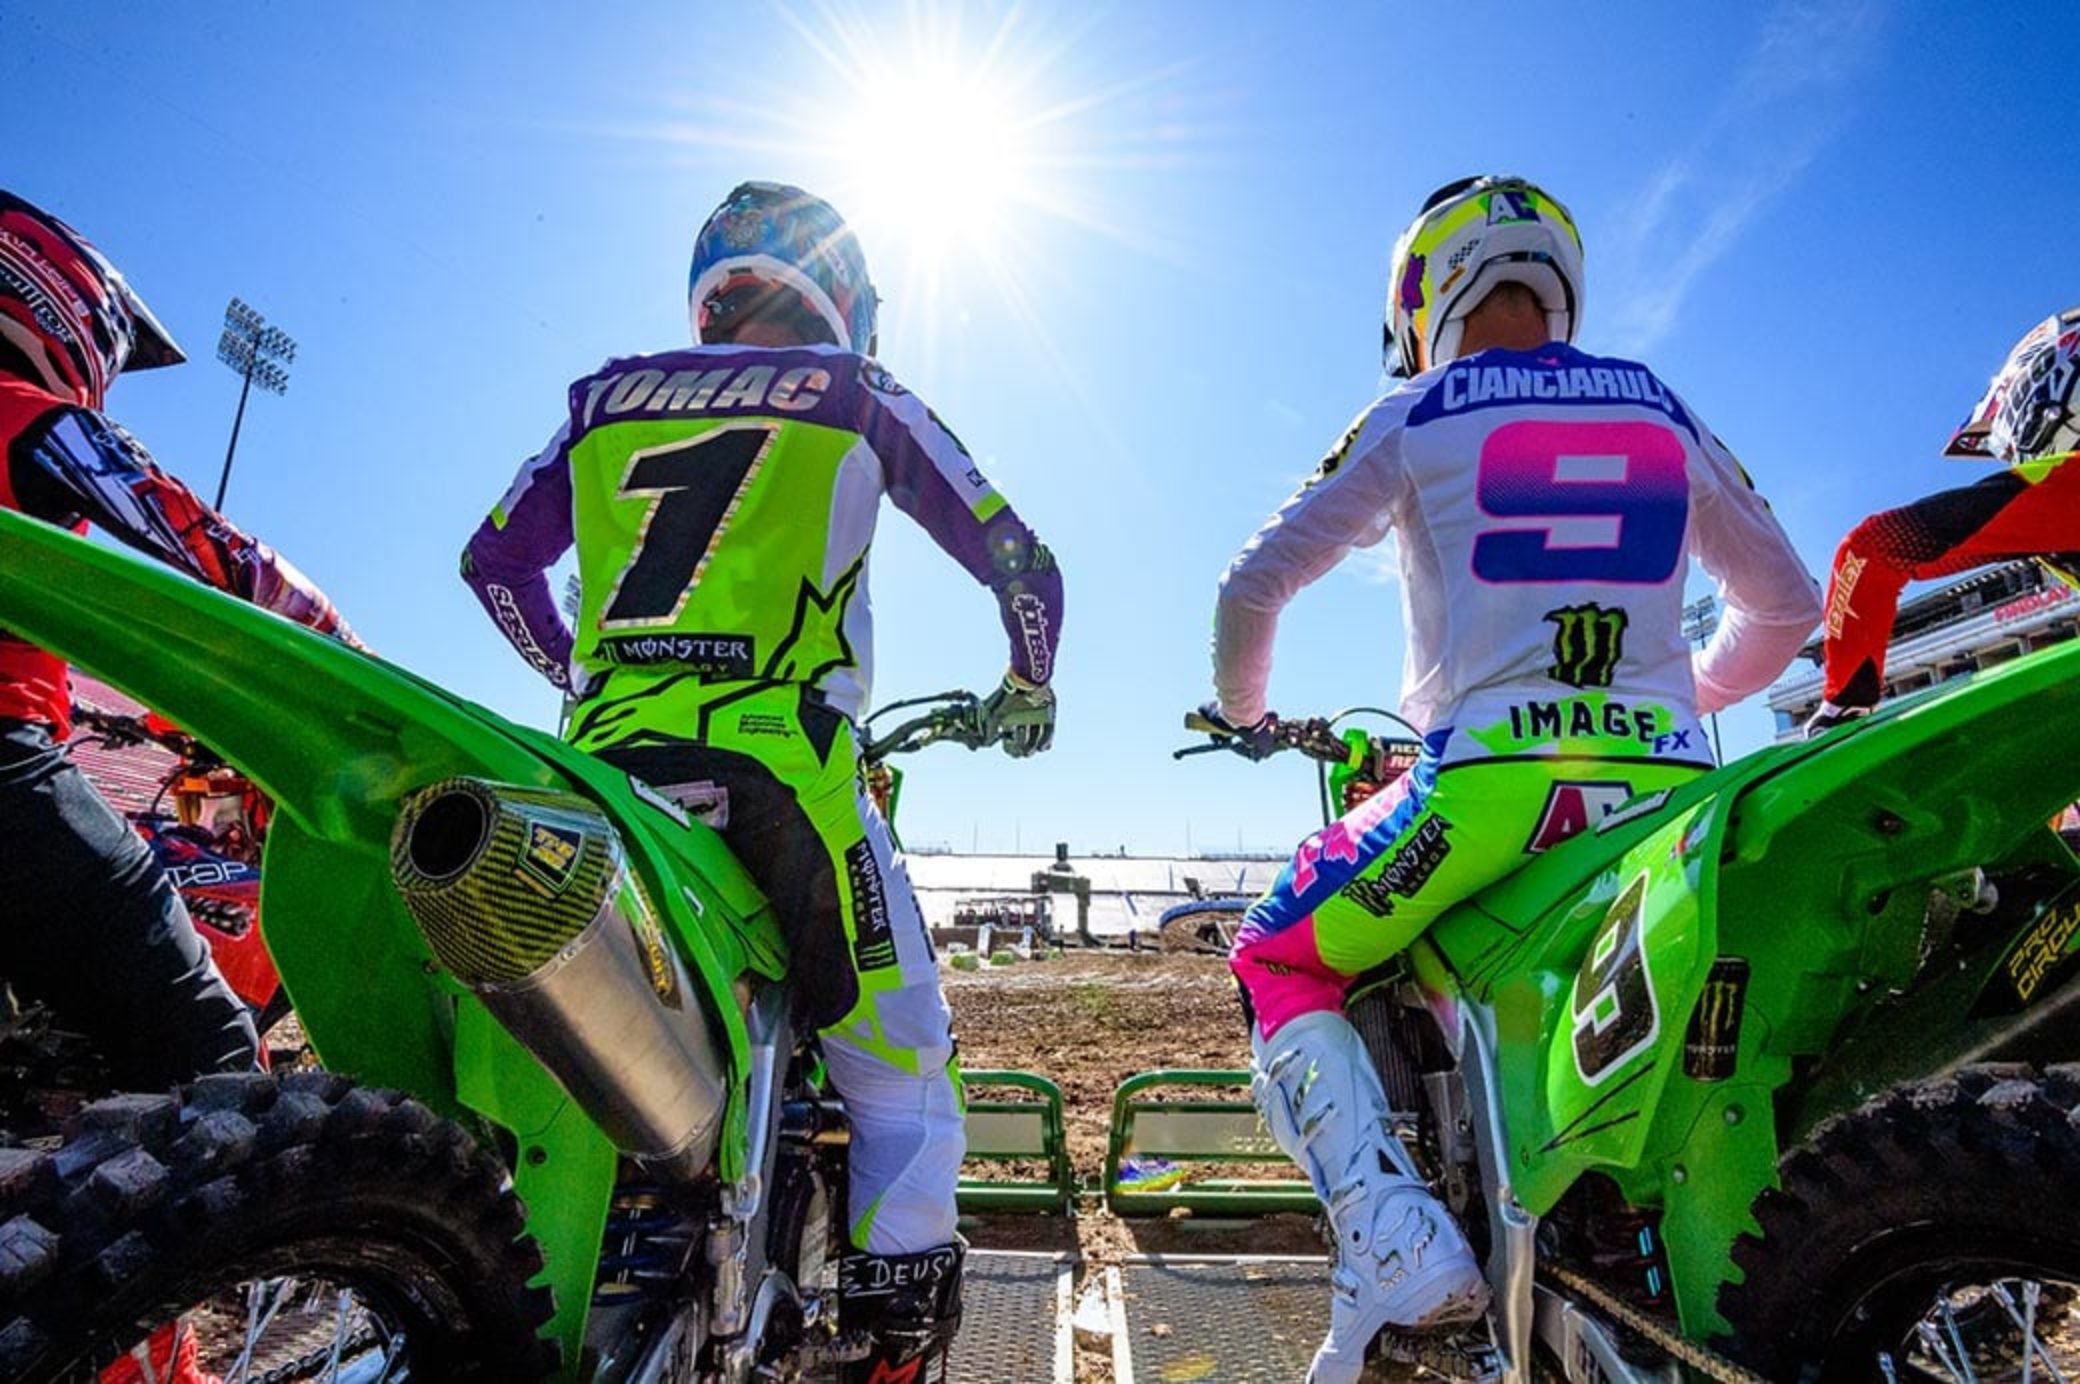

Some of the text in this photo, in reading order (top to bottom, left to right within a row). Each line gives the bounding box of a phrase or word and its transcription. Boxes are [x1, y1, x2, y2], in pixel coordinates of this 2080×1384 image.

[583, 365, 832, 429] TOMAC
[599, 421, 780, 629] 1
[1470, 420, 1689, 585] 9
[621, 633, 749, 661] MONSTER
[1509, 701, 1690, 753] IMAGE FX
[2008, 908, 2058, 978] PRO
